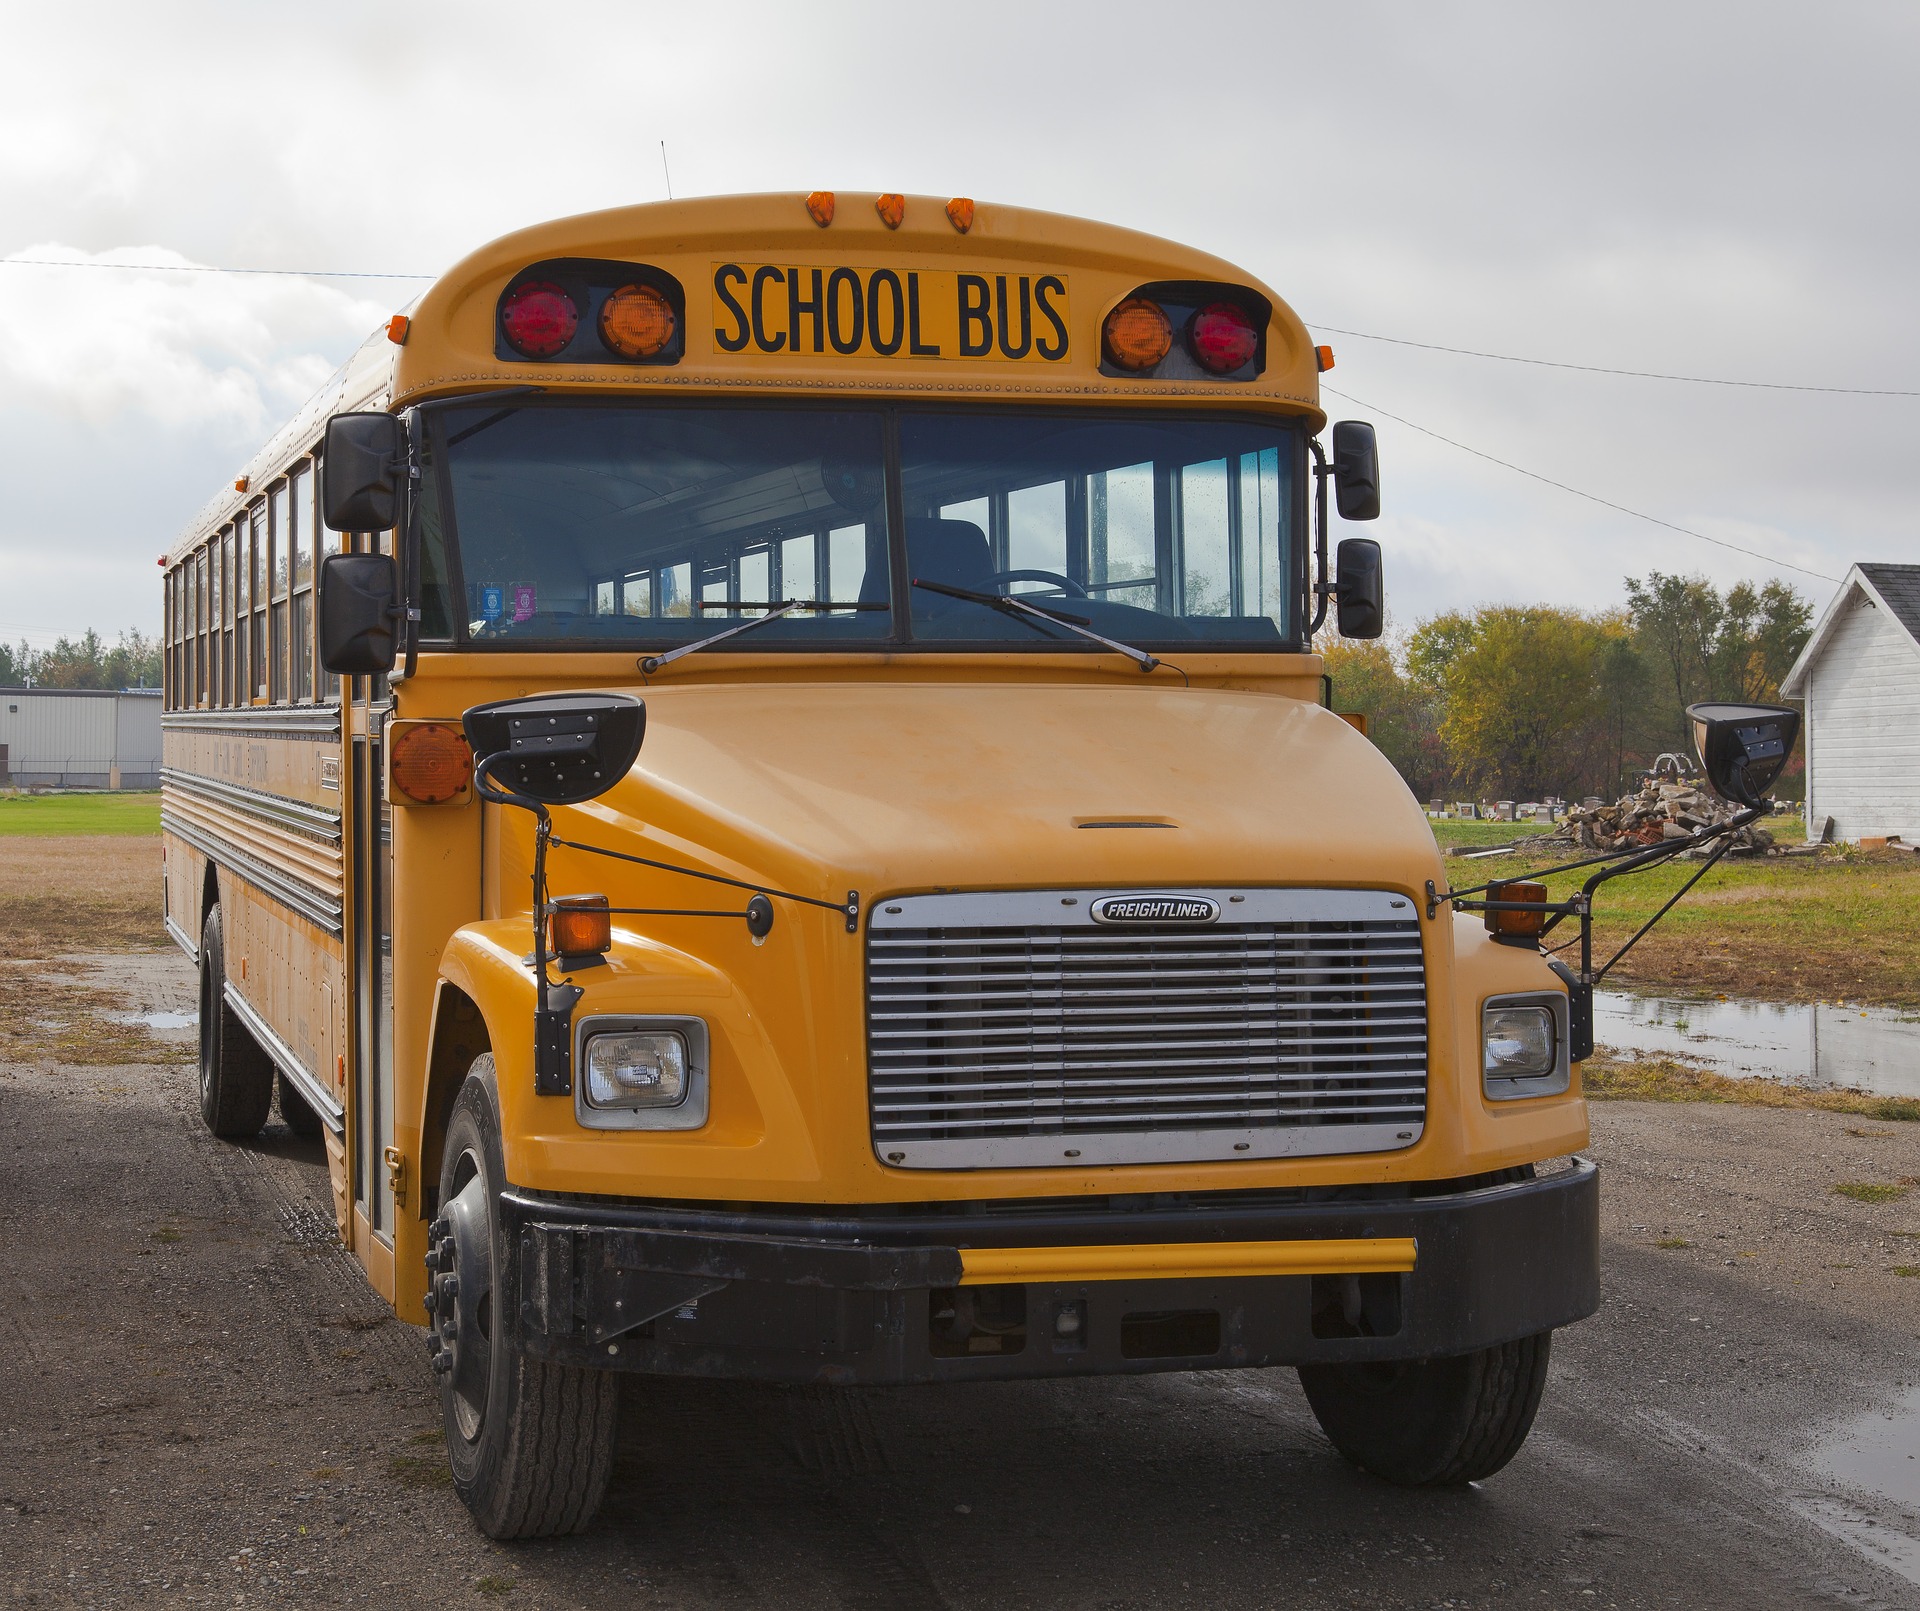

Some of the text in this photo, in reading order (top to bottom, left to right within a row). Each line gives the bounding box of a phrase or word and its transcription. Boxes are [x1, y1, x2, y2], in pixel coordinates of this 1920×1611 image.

[714, 264, 1069, 361] SCHOOL BUS
[1108, 902, 1207, 917] FREIGHTLINER
